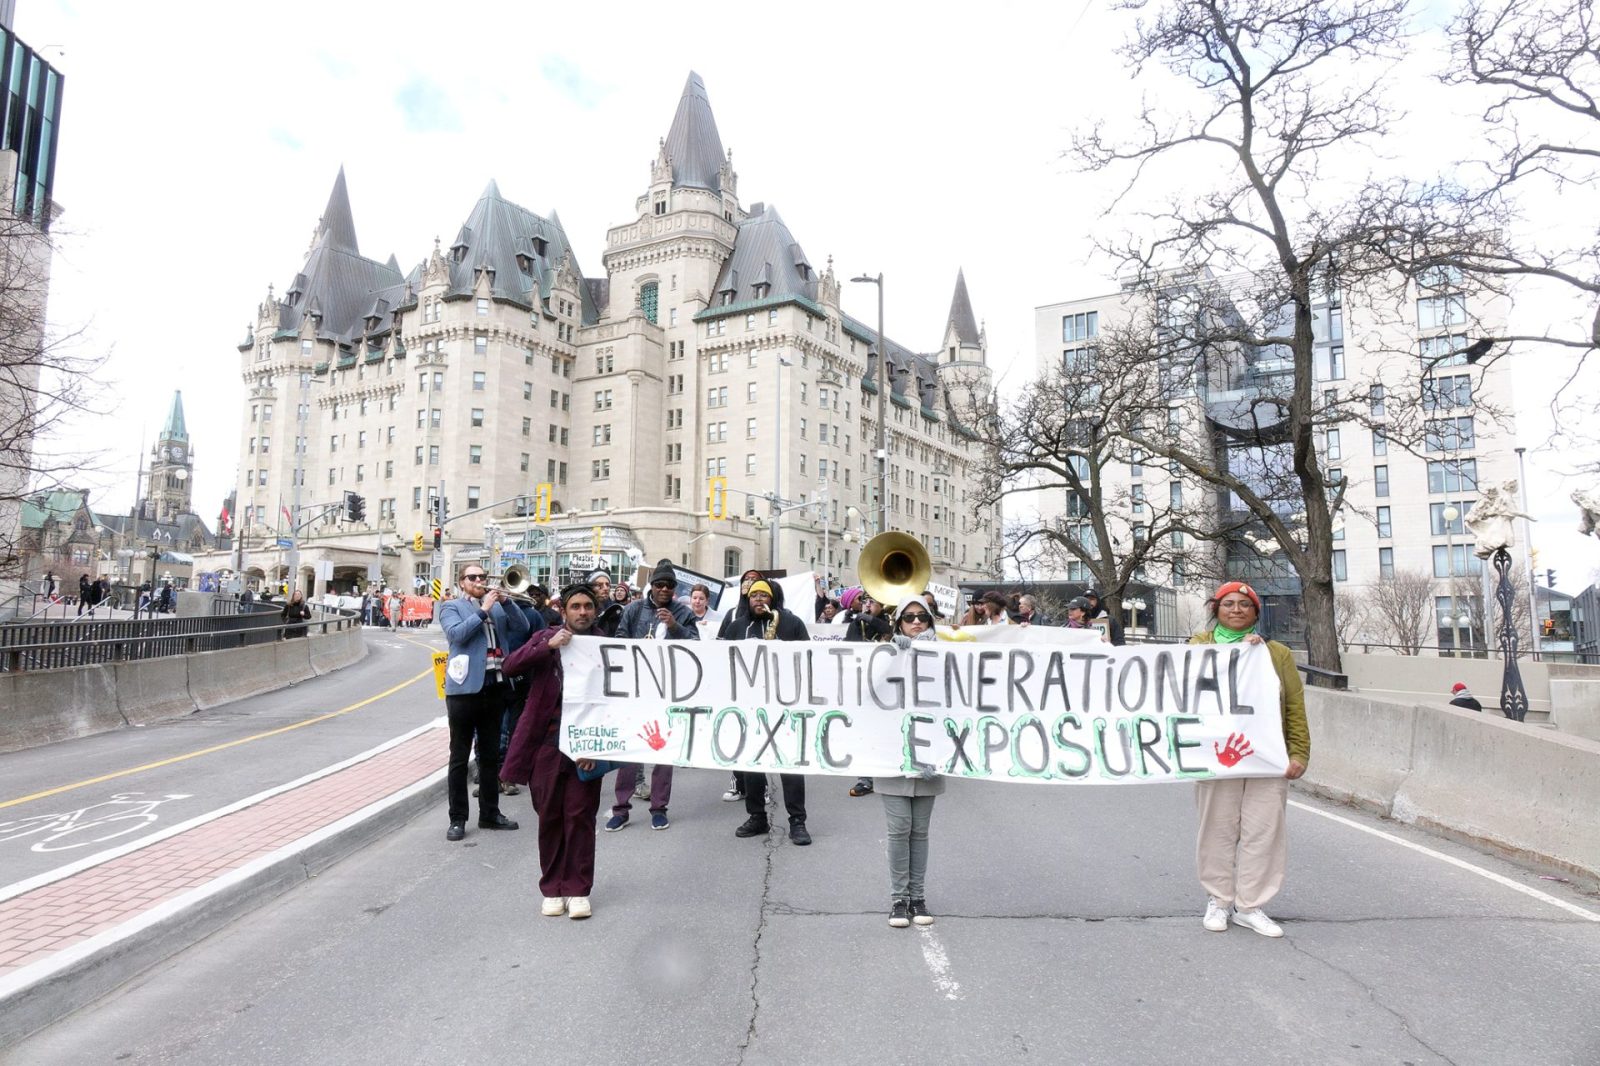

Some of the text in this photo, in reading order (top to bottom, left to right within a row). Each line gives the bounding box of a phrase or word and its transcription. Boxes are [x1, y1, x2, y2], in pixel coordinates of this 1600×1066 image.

[934, 585, 956, 598] MORE
[600, 644, 703, 703] END
[666, 705, 1216, 778] TOXIC EXPOSURE
